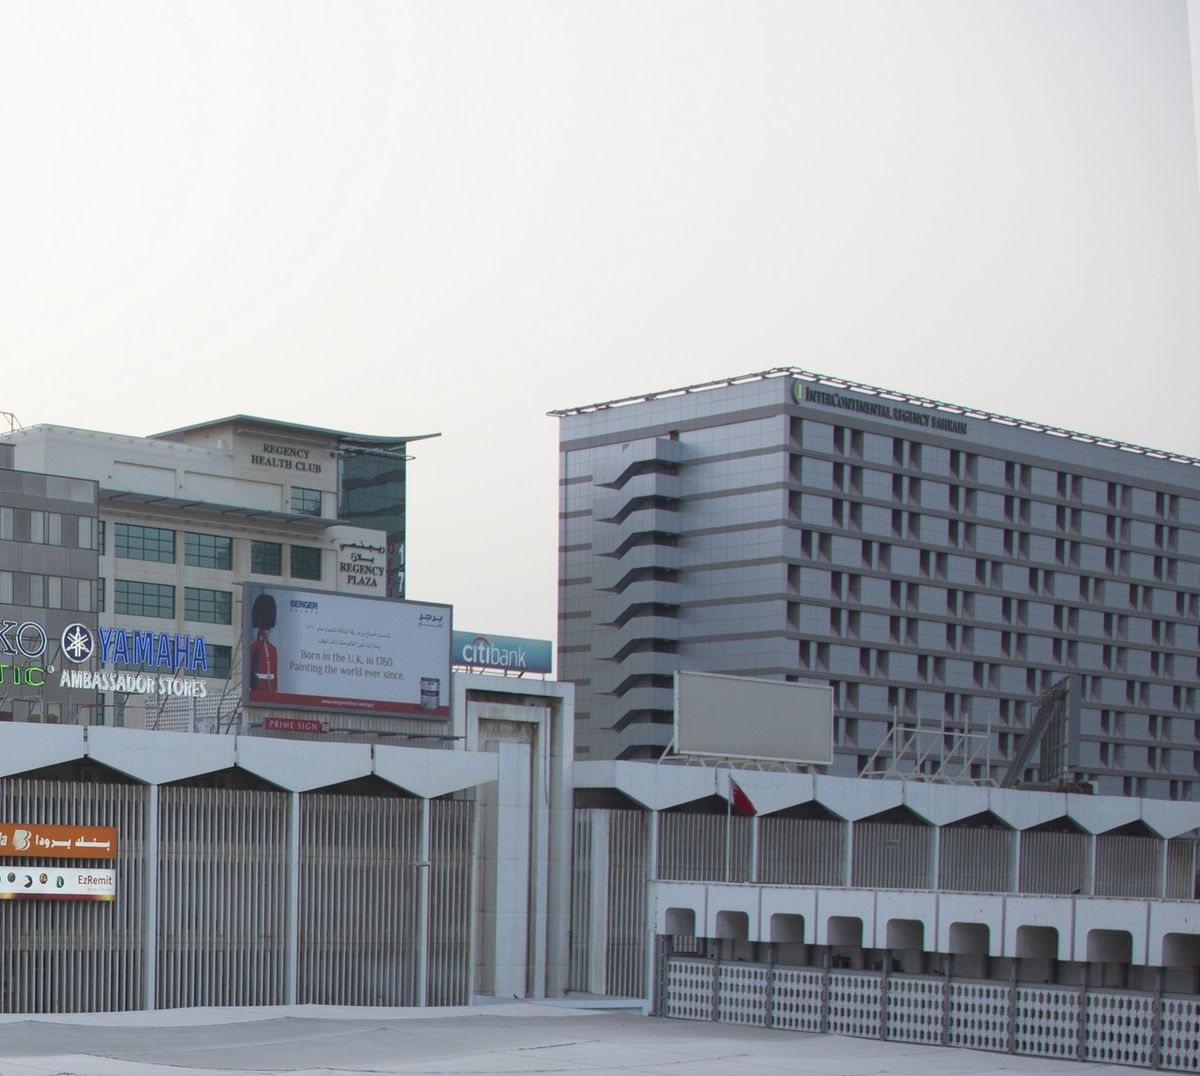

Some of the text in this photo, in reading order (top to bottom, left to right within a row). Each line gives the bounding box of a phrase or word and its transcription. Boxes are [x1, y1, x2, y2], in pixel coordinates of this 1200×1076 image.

[263, 443, 310, 459] REGENCY
[251, 454, 322, 474] HEALTH CLUB
[340, 562, 385, 577] REGENCY
[347, 575, 378, 587] PLAZA
[289, 599, 318, 610] BERGER
[97, 626, 208, 672] YAMAHA
[301, 649, 321, 660] Born
[323, 651, 331, 661] in
[332, 652, 346, 663] the
[366, 656, 374, 665] in
[462, 638, 526, 668] citibank
[289, 660, 323, 675] Painting
[325, 665, 338, 674] the
[340, 666, 362, 677] world
[364, 670, 381, 679] ever
[59, 669, 207, 698] AMBASSADOR STORES
[269, 720, 318, 731] PRIME SIGN
[35, 834, 110, 852] بنك برودا
[78, 875, 112, 885] EzRemit
